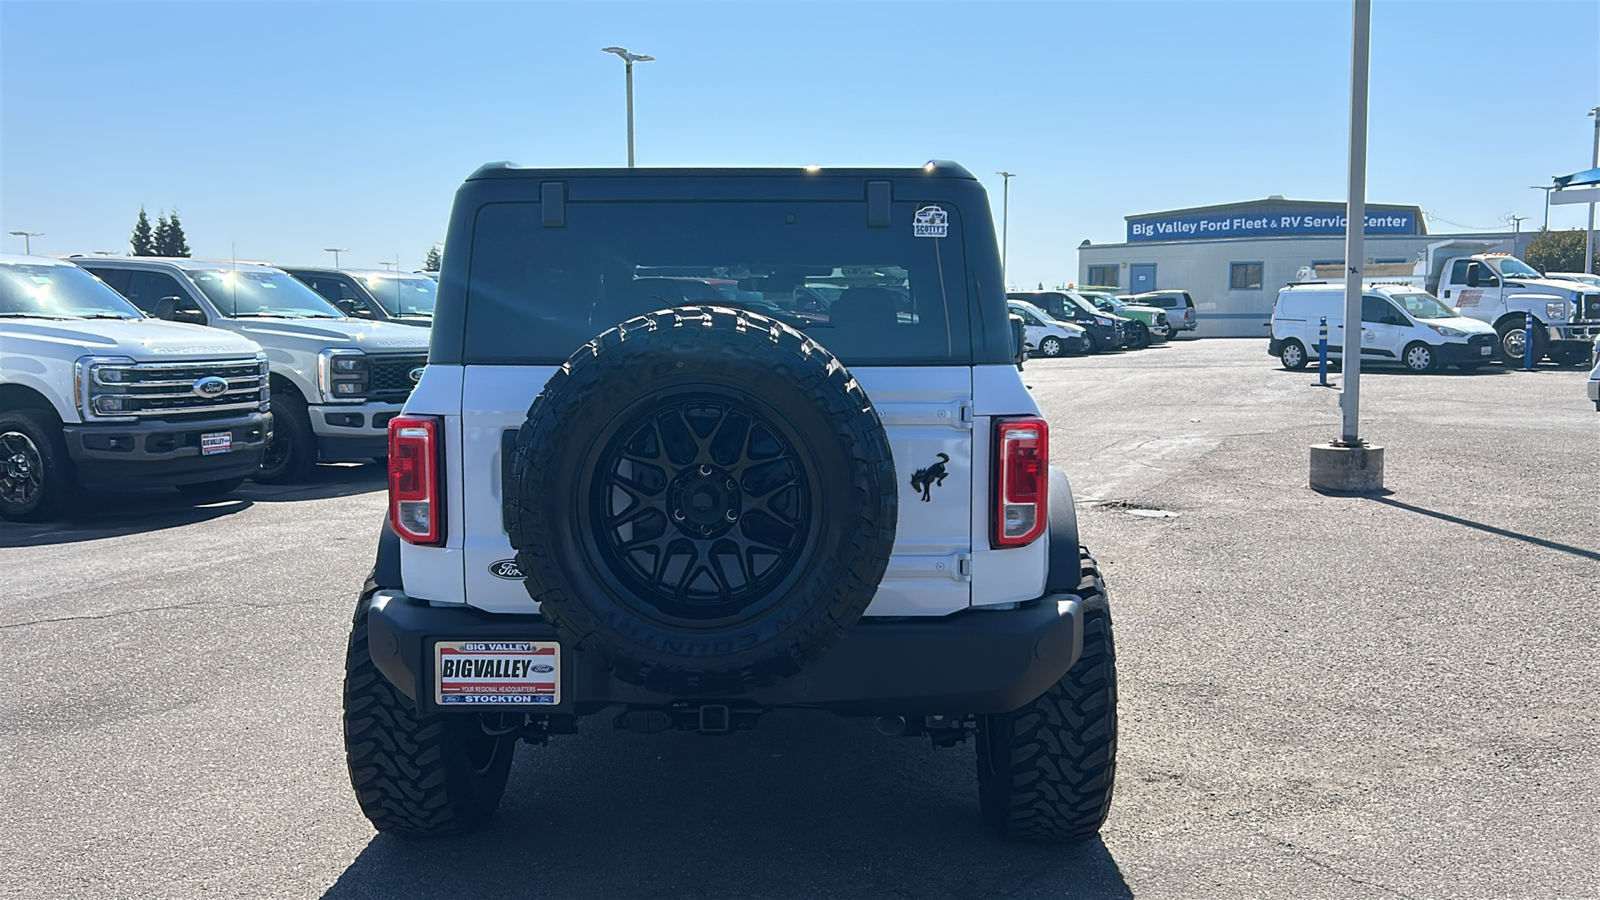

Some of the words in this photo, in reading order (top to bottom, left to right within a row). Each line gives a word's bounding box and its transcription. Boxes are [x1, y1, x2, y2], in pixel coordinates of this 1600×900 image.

[1133, 223, 1154, 236] Big
[1156, 221, 1197, 234] Valley
[1200, 219, 1230, 232] Ford
[1233, 217, 1268, 230] Fleet
[1270, 220, 1278, 228] &
[1281, 216, 1301, 228] RV
[1303, 215, 1347, 228] Servic
[205, 382, 222, 392] Ford
[498, 562, 522, 576] For
[466, 643, 486, 651] BIG
[488, 643, 530, 651] VALLEY
[443, 659, 532, 678] BIGVALLEY
